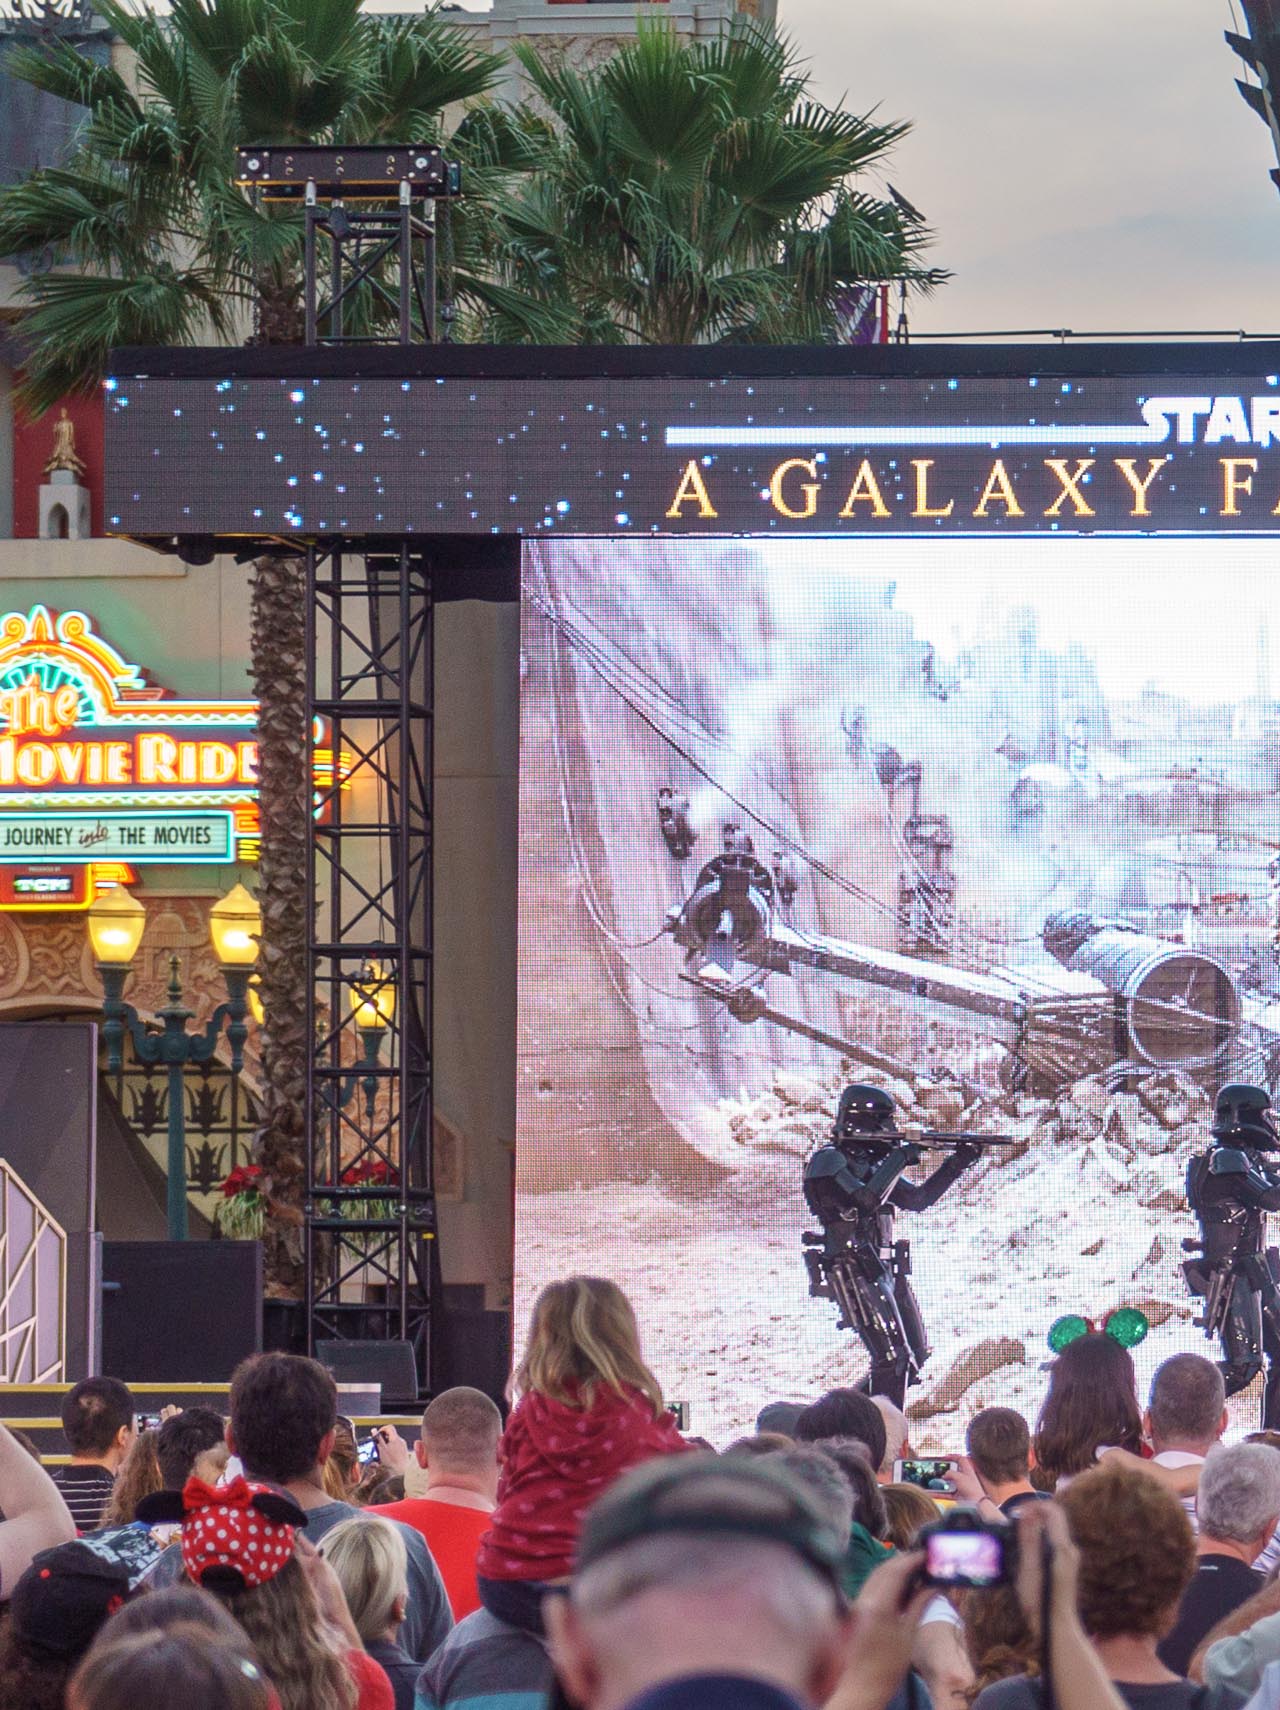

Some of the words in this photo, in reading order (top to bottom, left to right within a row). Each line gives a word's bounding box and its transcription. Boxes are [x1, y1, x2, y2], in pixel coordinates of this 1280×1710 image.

[665, 459, 718, 519] A
[769, 457, 1166, 519] GALAXY
[0, 673, 79, 736] The
[4, 827, 73, 846] JOURNEY
[119, 827, 146, 845] THE
[153, 826, 211, 844] MOVIES
